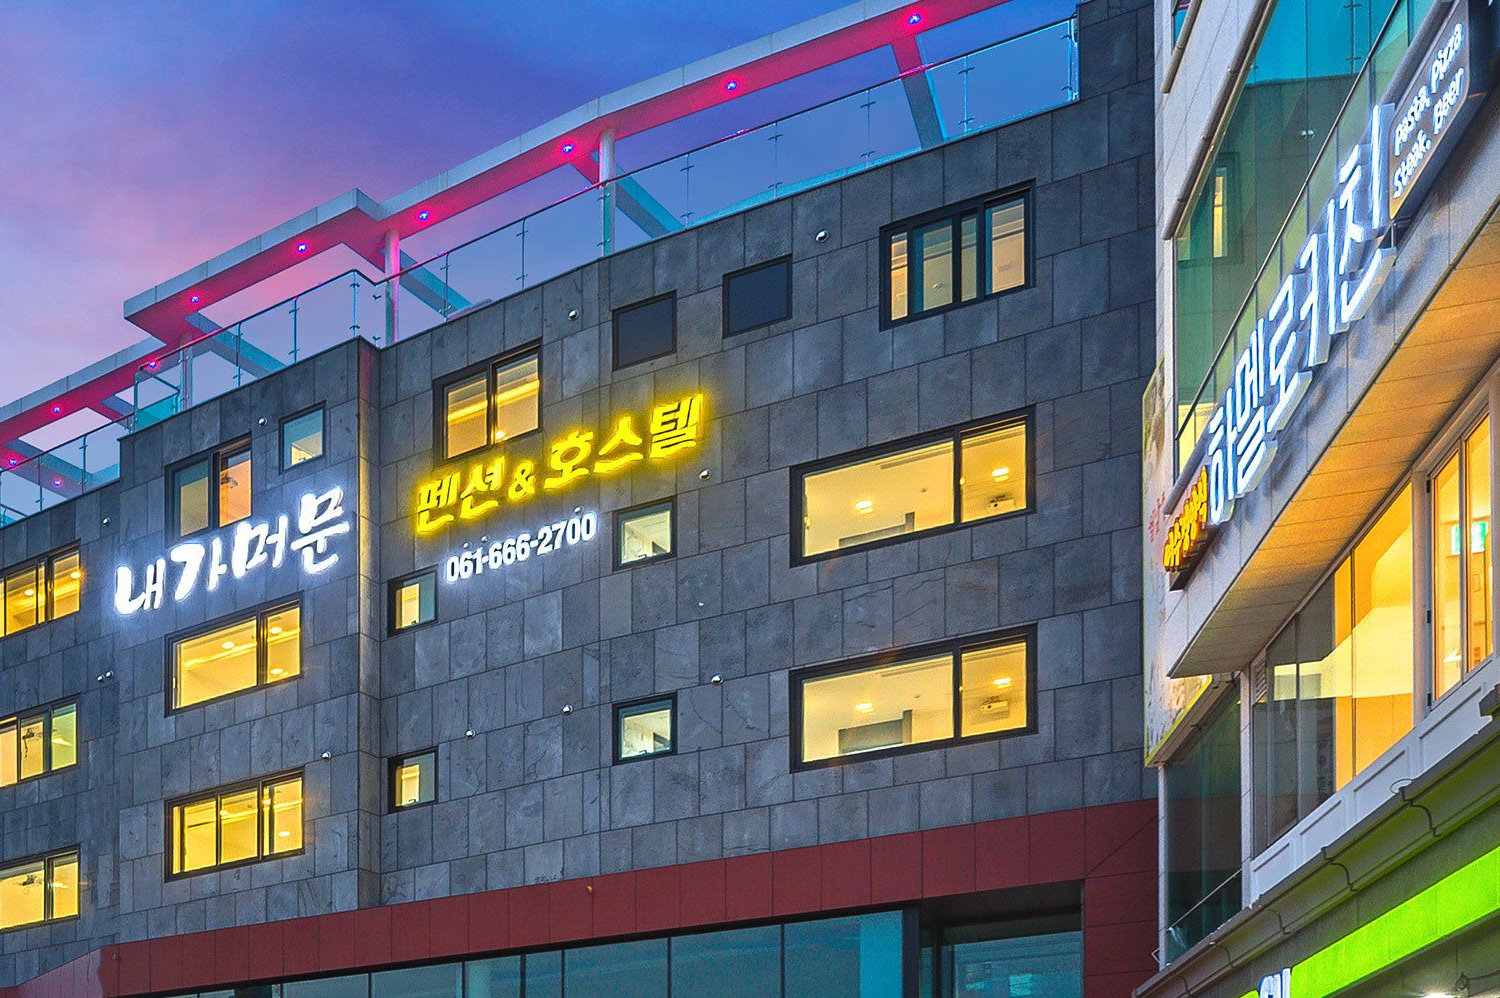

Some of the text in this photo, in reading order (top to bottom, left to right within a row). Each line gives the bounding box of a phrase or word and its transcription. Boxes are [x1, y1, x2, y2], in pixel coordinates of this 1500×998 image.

[1434, 67, 1464, 135] Beer
[1208, 104, 1388, 523] 하멜로키친
[115, 486, 350, 615] 내가머문
[446, 512, 597, 583] 061-666-2700
